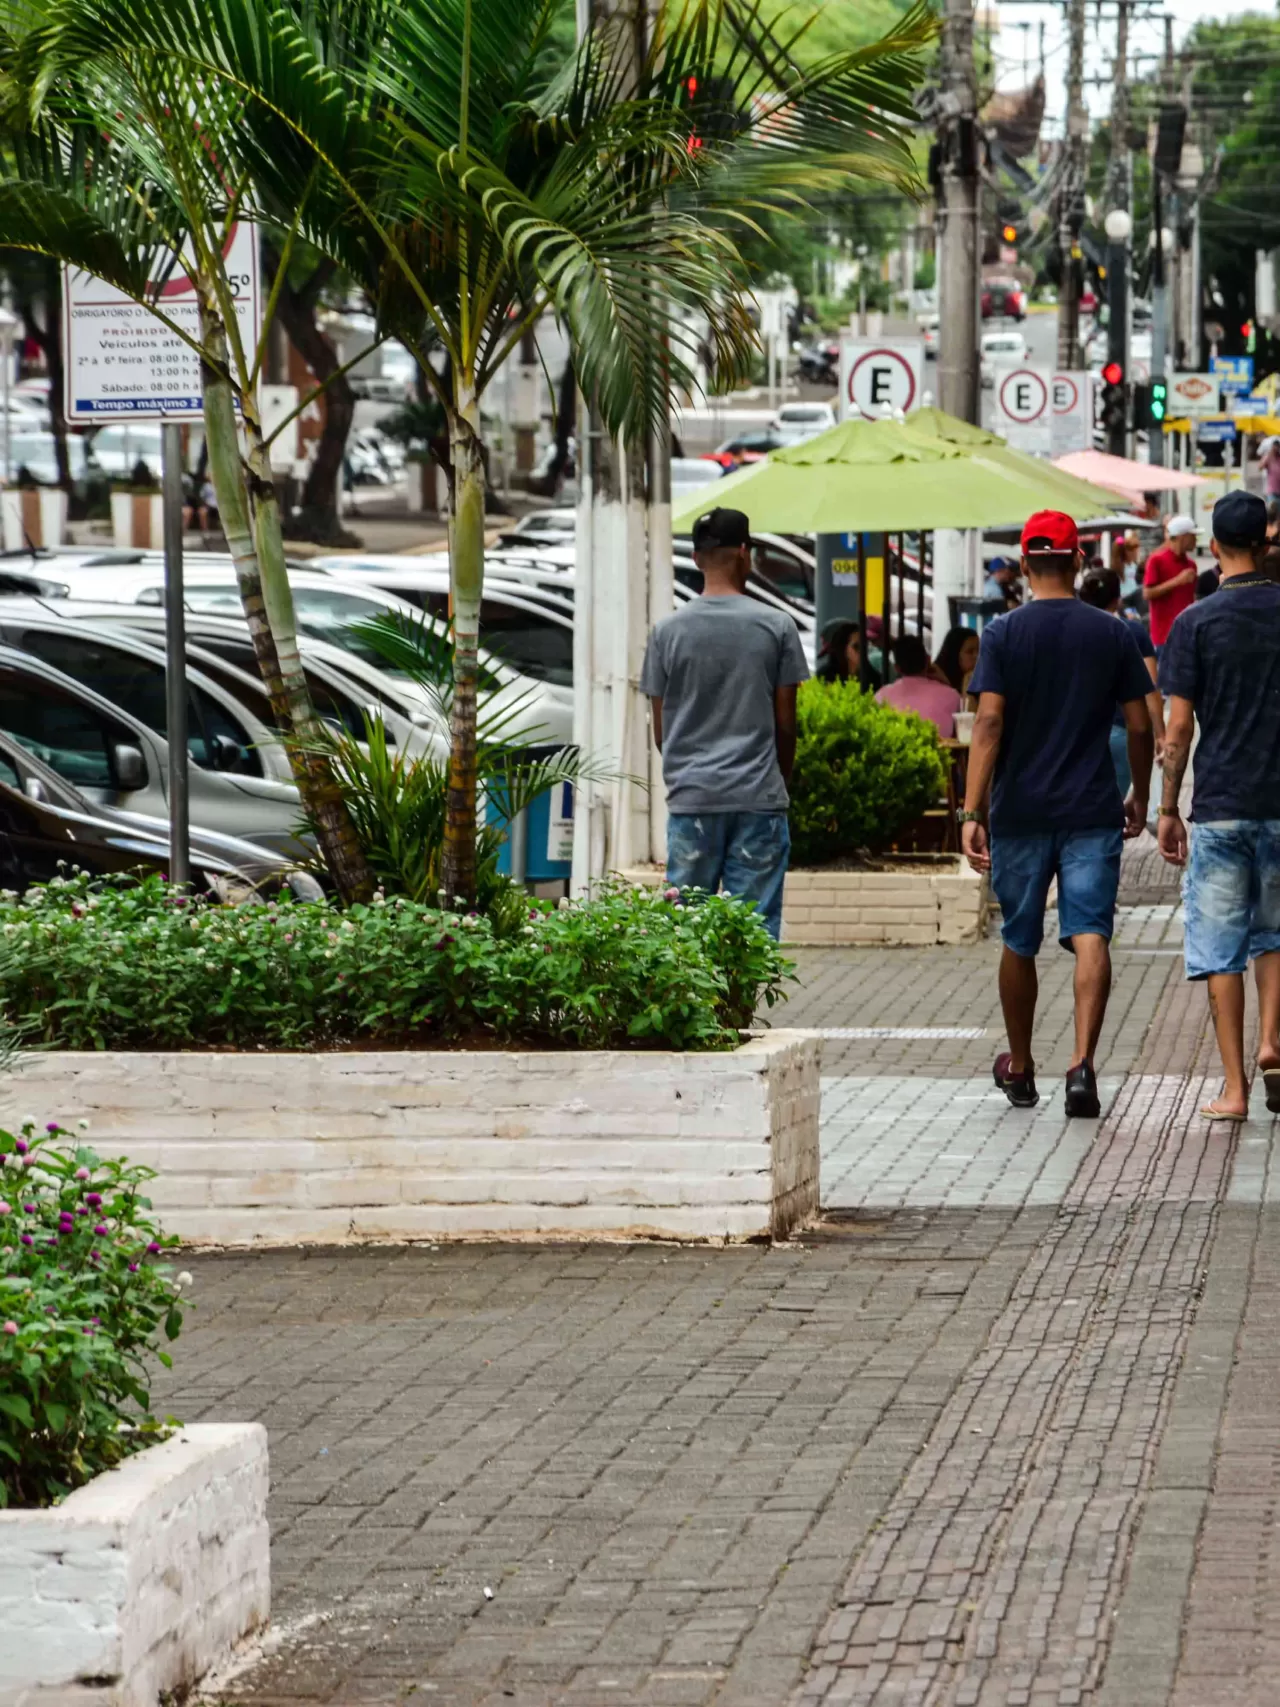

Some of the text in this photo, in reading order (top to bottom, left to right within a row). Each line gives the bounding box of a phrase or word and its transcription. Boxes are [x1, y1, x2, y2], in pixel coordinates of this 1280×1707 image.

[870, 367, 892, 405] E
[1016, 384, 1030, 410] E
[91, 399, 134, 412] Tempo
[137, 398, 188, 409] máximo
